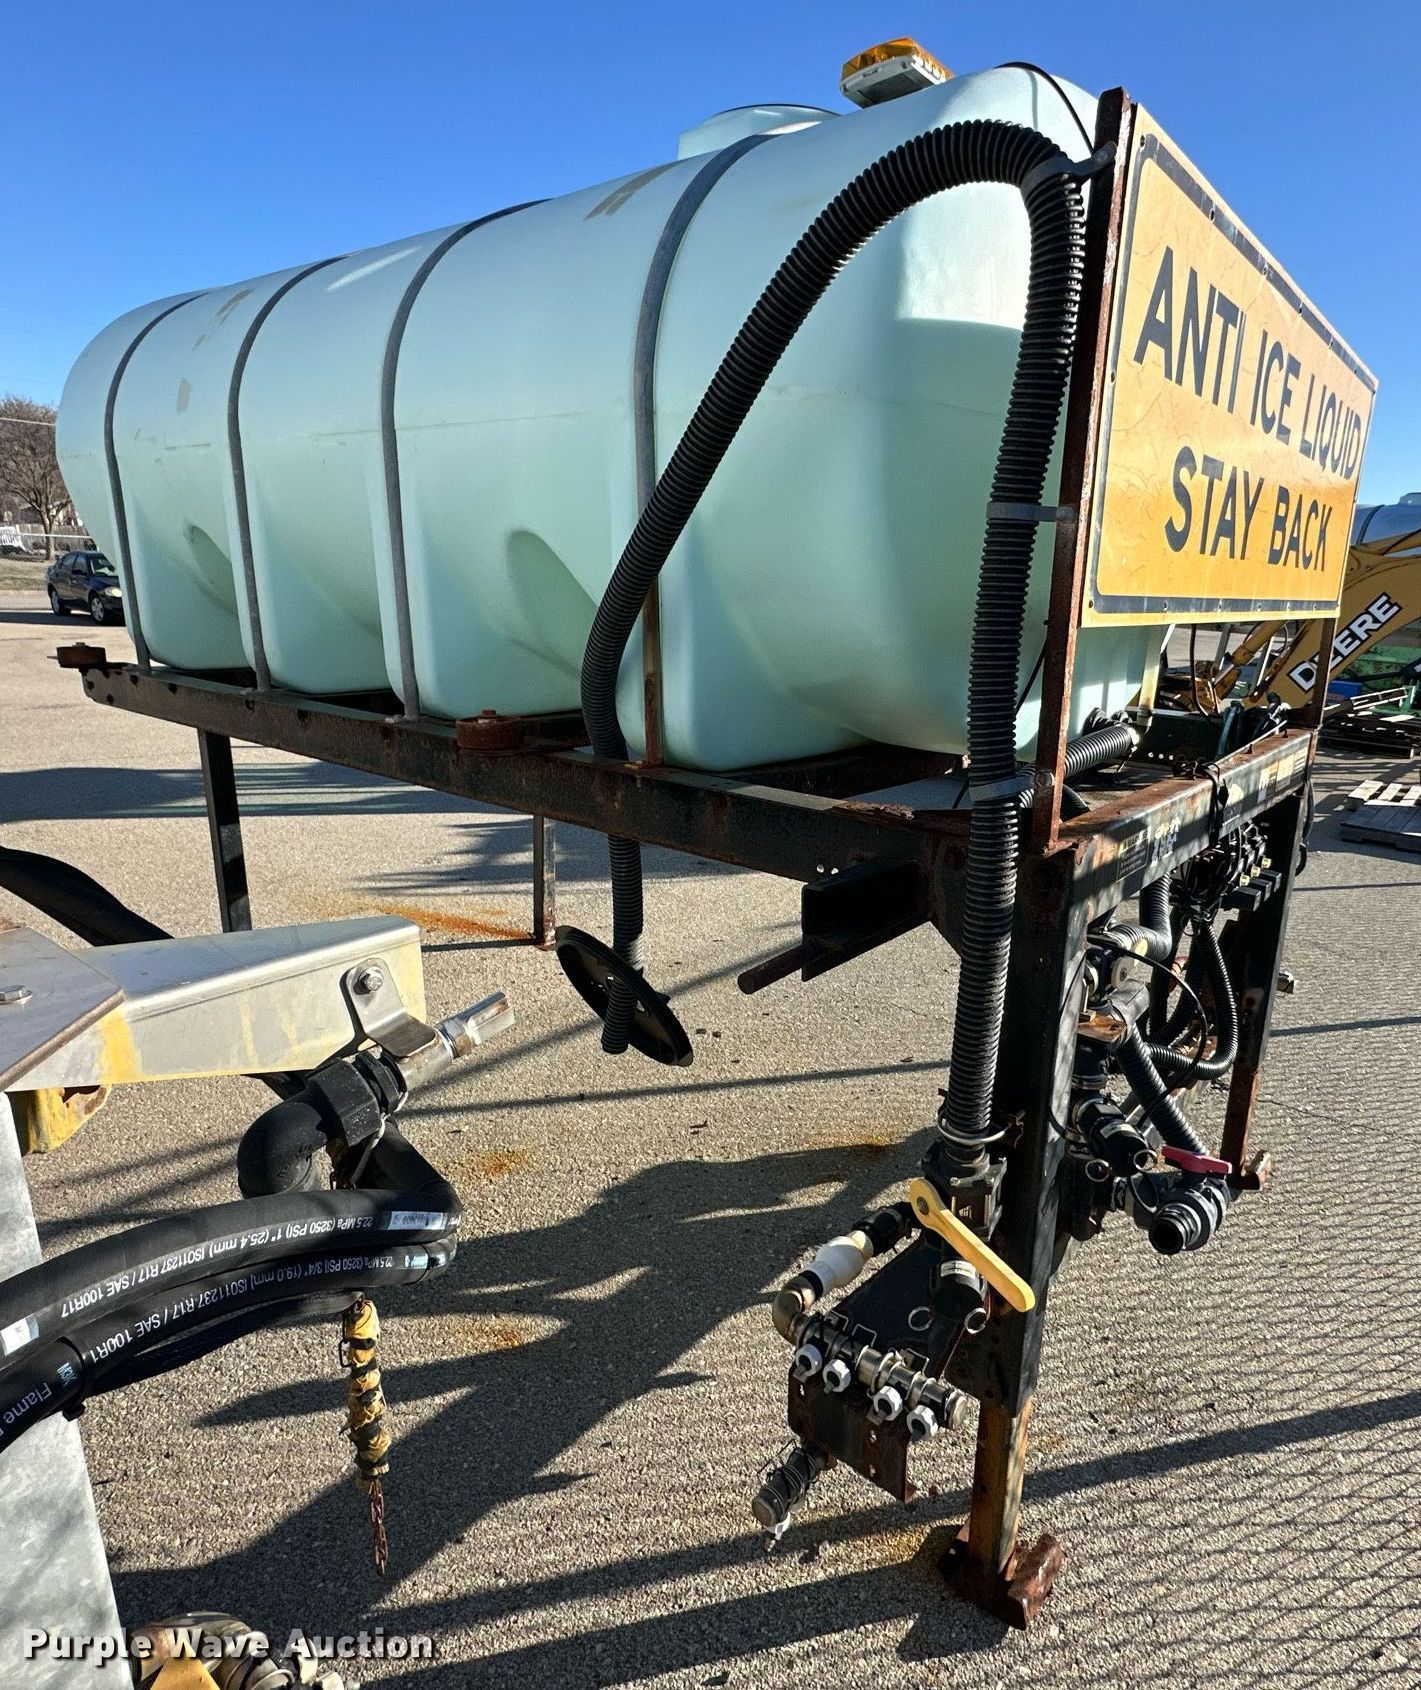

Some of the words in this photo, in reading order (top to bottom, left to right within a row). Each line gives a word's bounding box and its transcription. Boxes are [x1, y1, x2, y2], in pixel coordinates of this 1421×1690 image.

[1133, 245, 1246, 415] ANTI
[1250, 329, 1301, 446] ICE
[1299, 373, 1361, 480] LIQUID
[1165, 446, 1265, 560] STAY
[1268, 485, 1333, 572] BACK
[286, 1223, 308, 1239] PSI)
[310, 1218, 336, 1234] (3250
[337, 1218, 356, 1230] MPa
[356, 1216, 374, 1229] 22.5
[240, 1228, 270, 1249] (25.4
[271, 1228, 282, 1242] 1"
[209, 1238, 237, 1258] mm)
[276, 1263, 302, 1282] (19.0
[342, 1256, 363, 1271] (3250
[131, 1271, 137, 1286] /
[138, 1264, 159, 1283] R17
[250, 1271, 275, 1290] mm)
[106, 1275, 130, 1297] SAE
[61, 1286, 104, 1318] 100R17
[172, 1298, 195, 1320] R17
[134, 1313, 161, 1338] SAE
[163, 1308, 168, 1324] /
[2, 1382, 53, 1424] Flame
